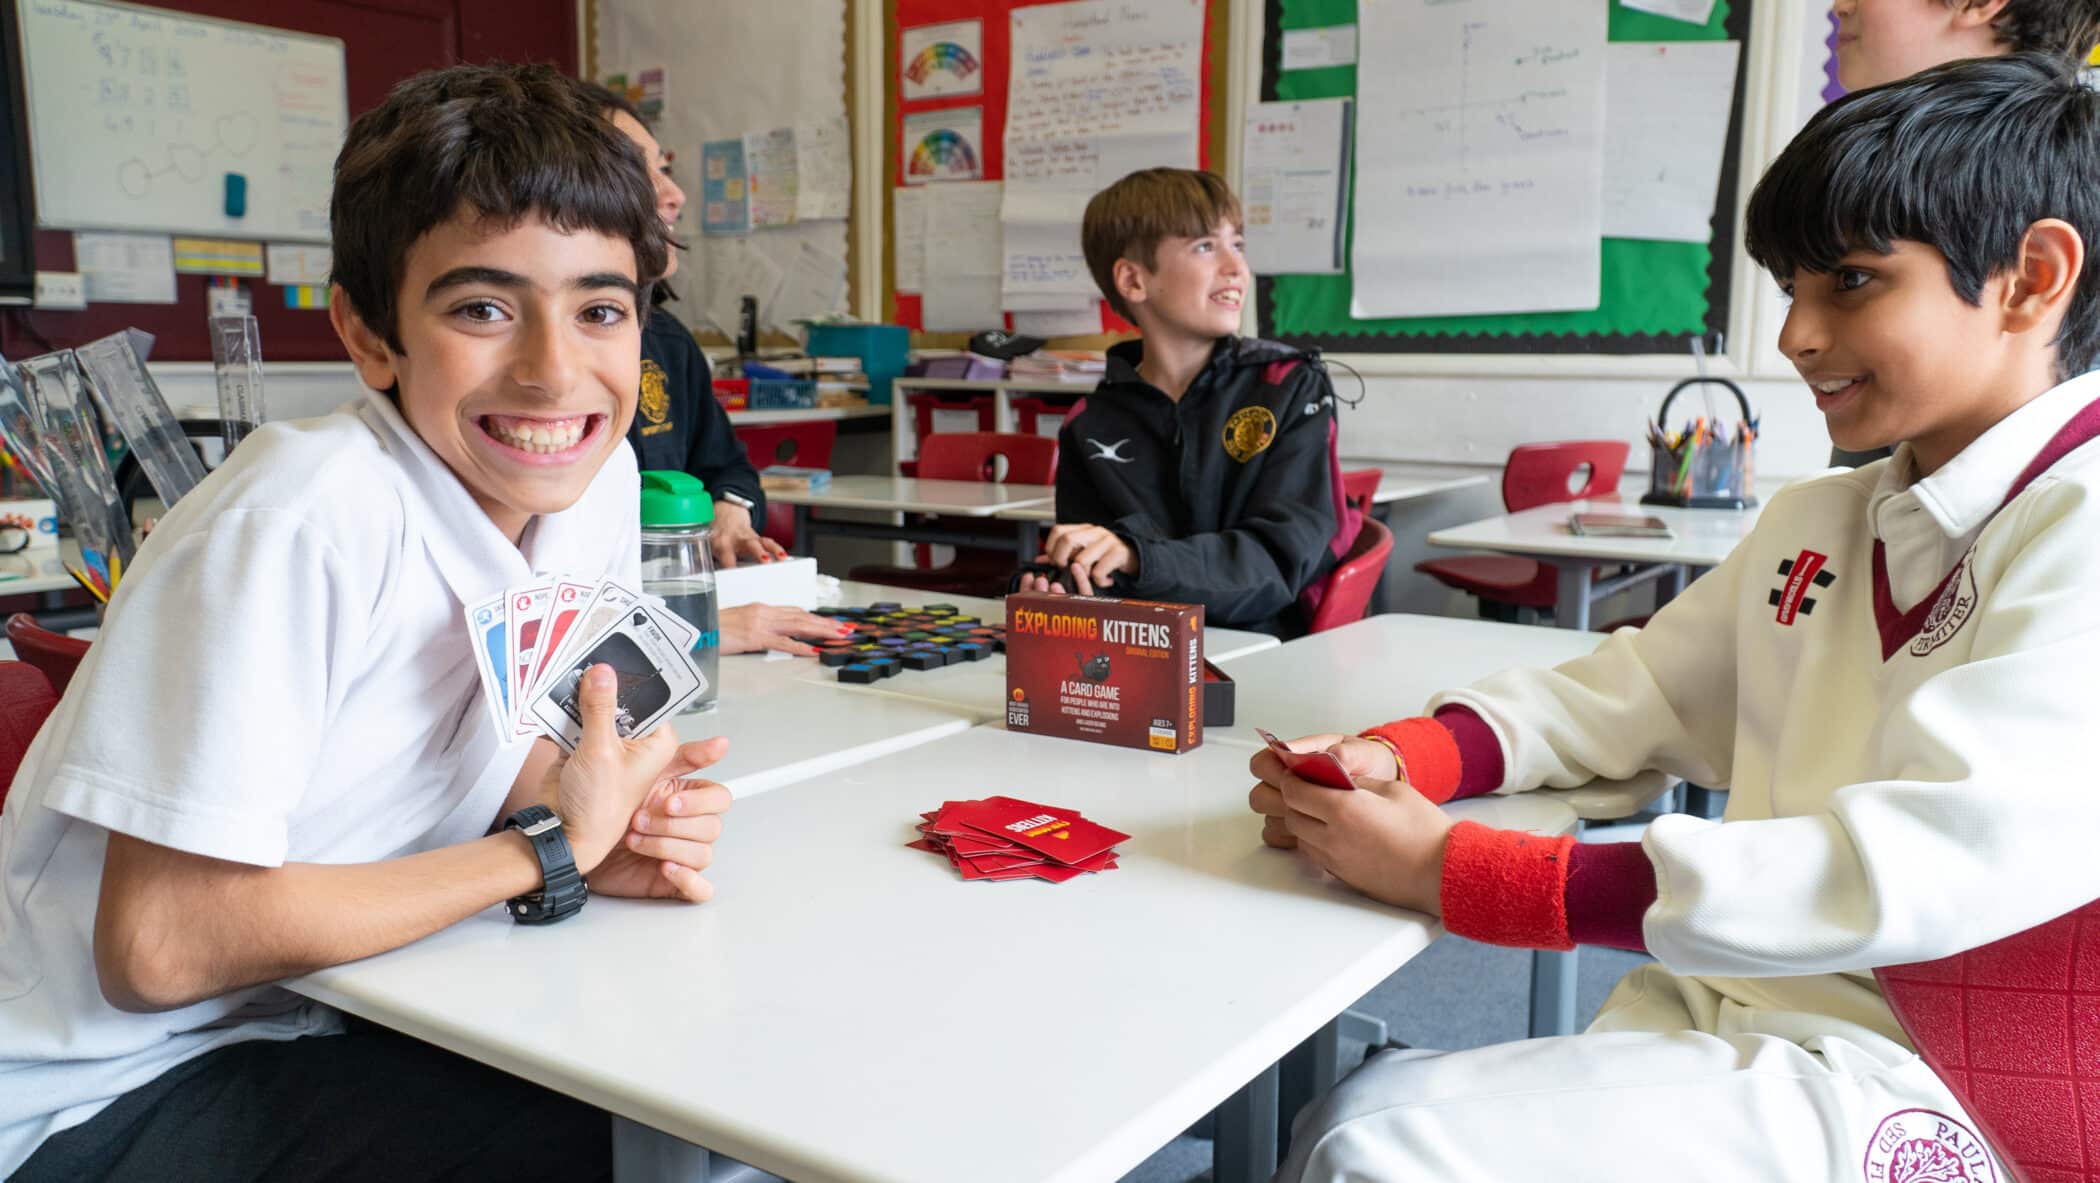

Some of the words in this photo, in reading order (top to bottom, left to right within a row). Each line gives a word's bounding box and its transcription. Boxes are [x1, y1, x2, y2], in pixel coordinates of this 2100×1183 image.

[1015, 608, 1097, 640] EXPLODING
[1103, 619, 1170, 648] KITTENS
[1188, 638, 1198, 684] KITTENS
[1060, 680, 1067, 694] A
[1068, 681, 1093, 697] CARD
[1094, 684, 1120, 701] GAME
[1008, 712, 1029, 727] EVER
[1188, 686, 1197, 745] EXPLODING
[1935, 1121, 1987, 1183] PAUL
